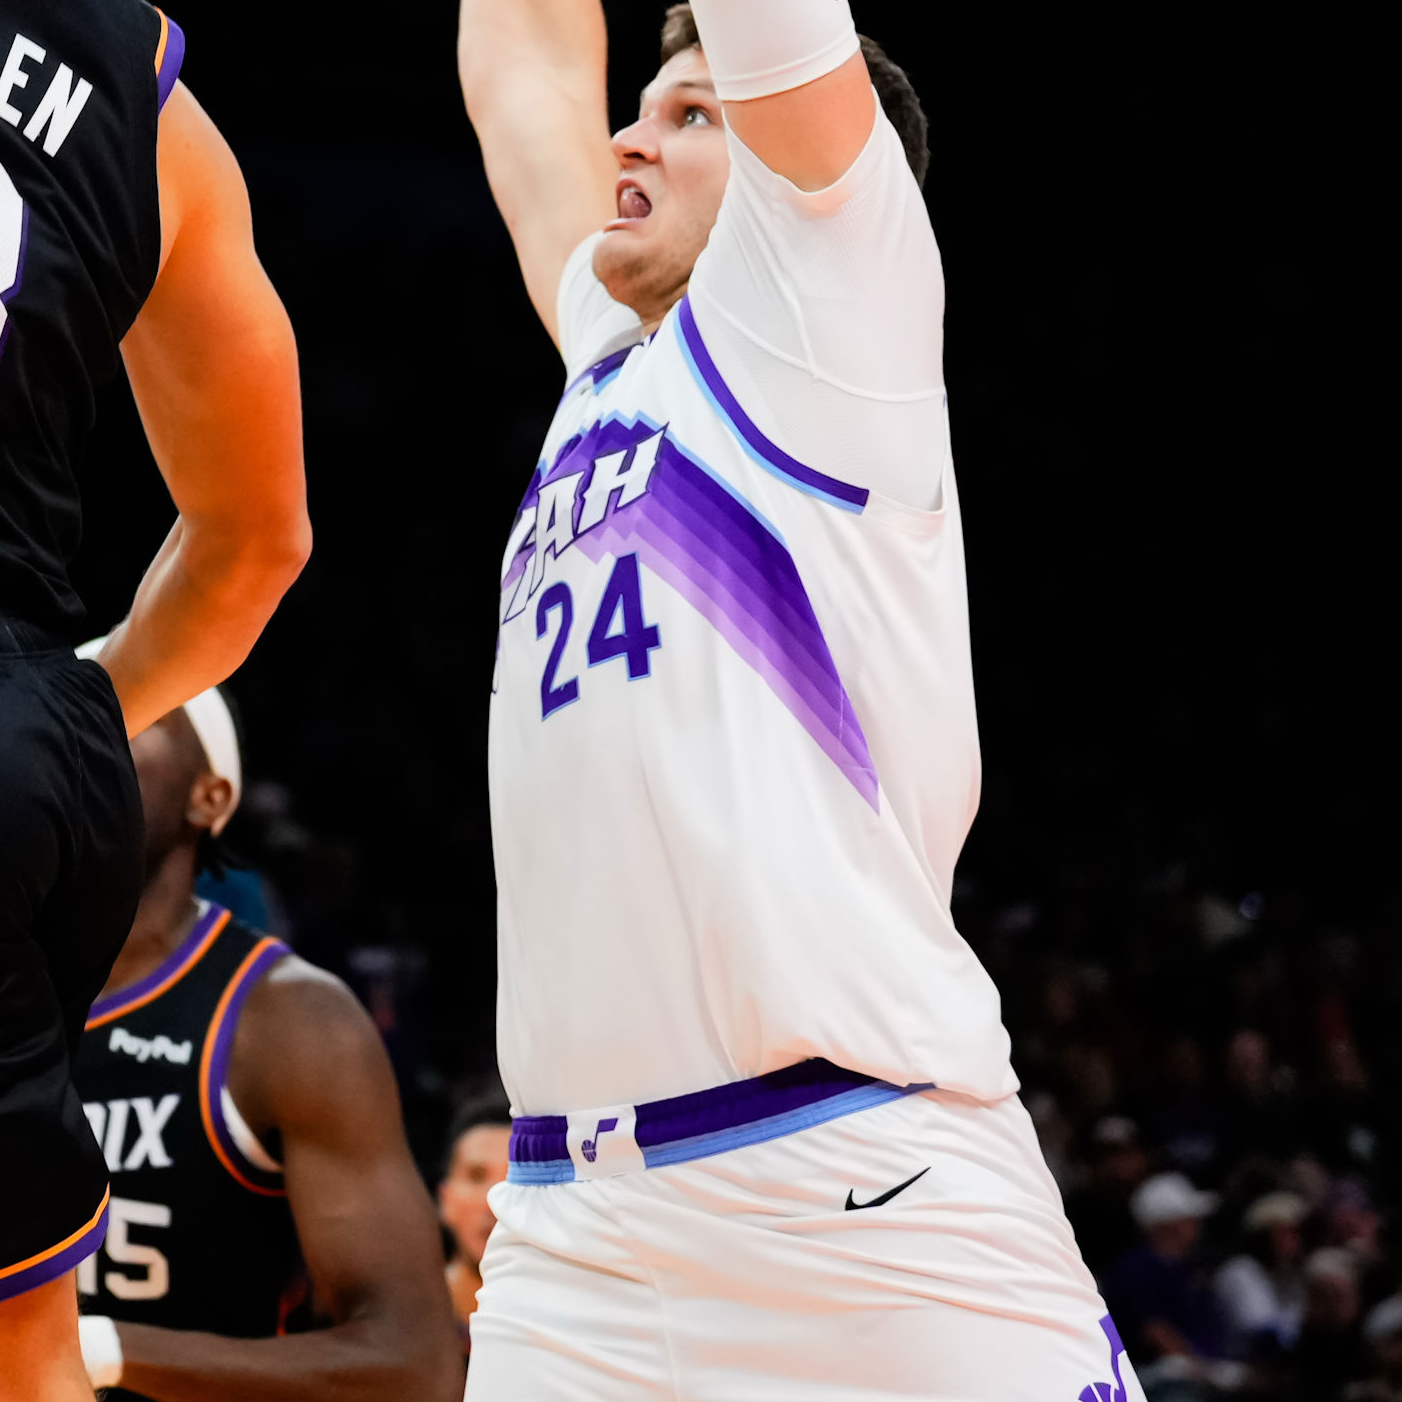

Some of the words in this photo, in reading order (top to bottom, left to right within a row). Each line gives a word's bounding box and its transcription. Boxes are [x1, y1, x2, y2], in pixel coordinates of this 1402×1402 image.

[500, 422, 669, 625] TAH
[536, 551, 662, 721] 24
[108, 1027, 193, 1065] PayPal
